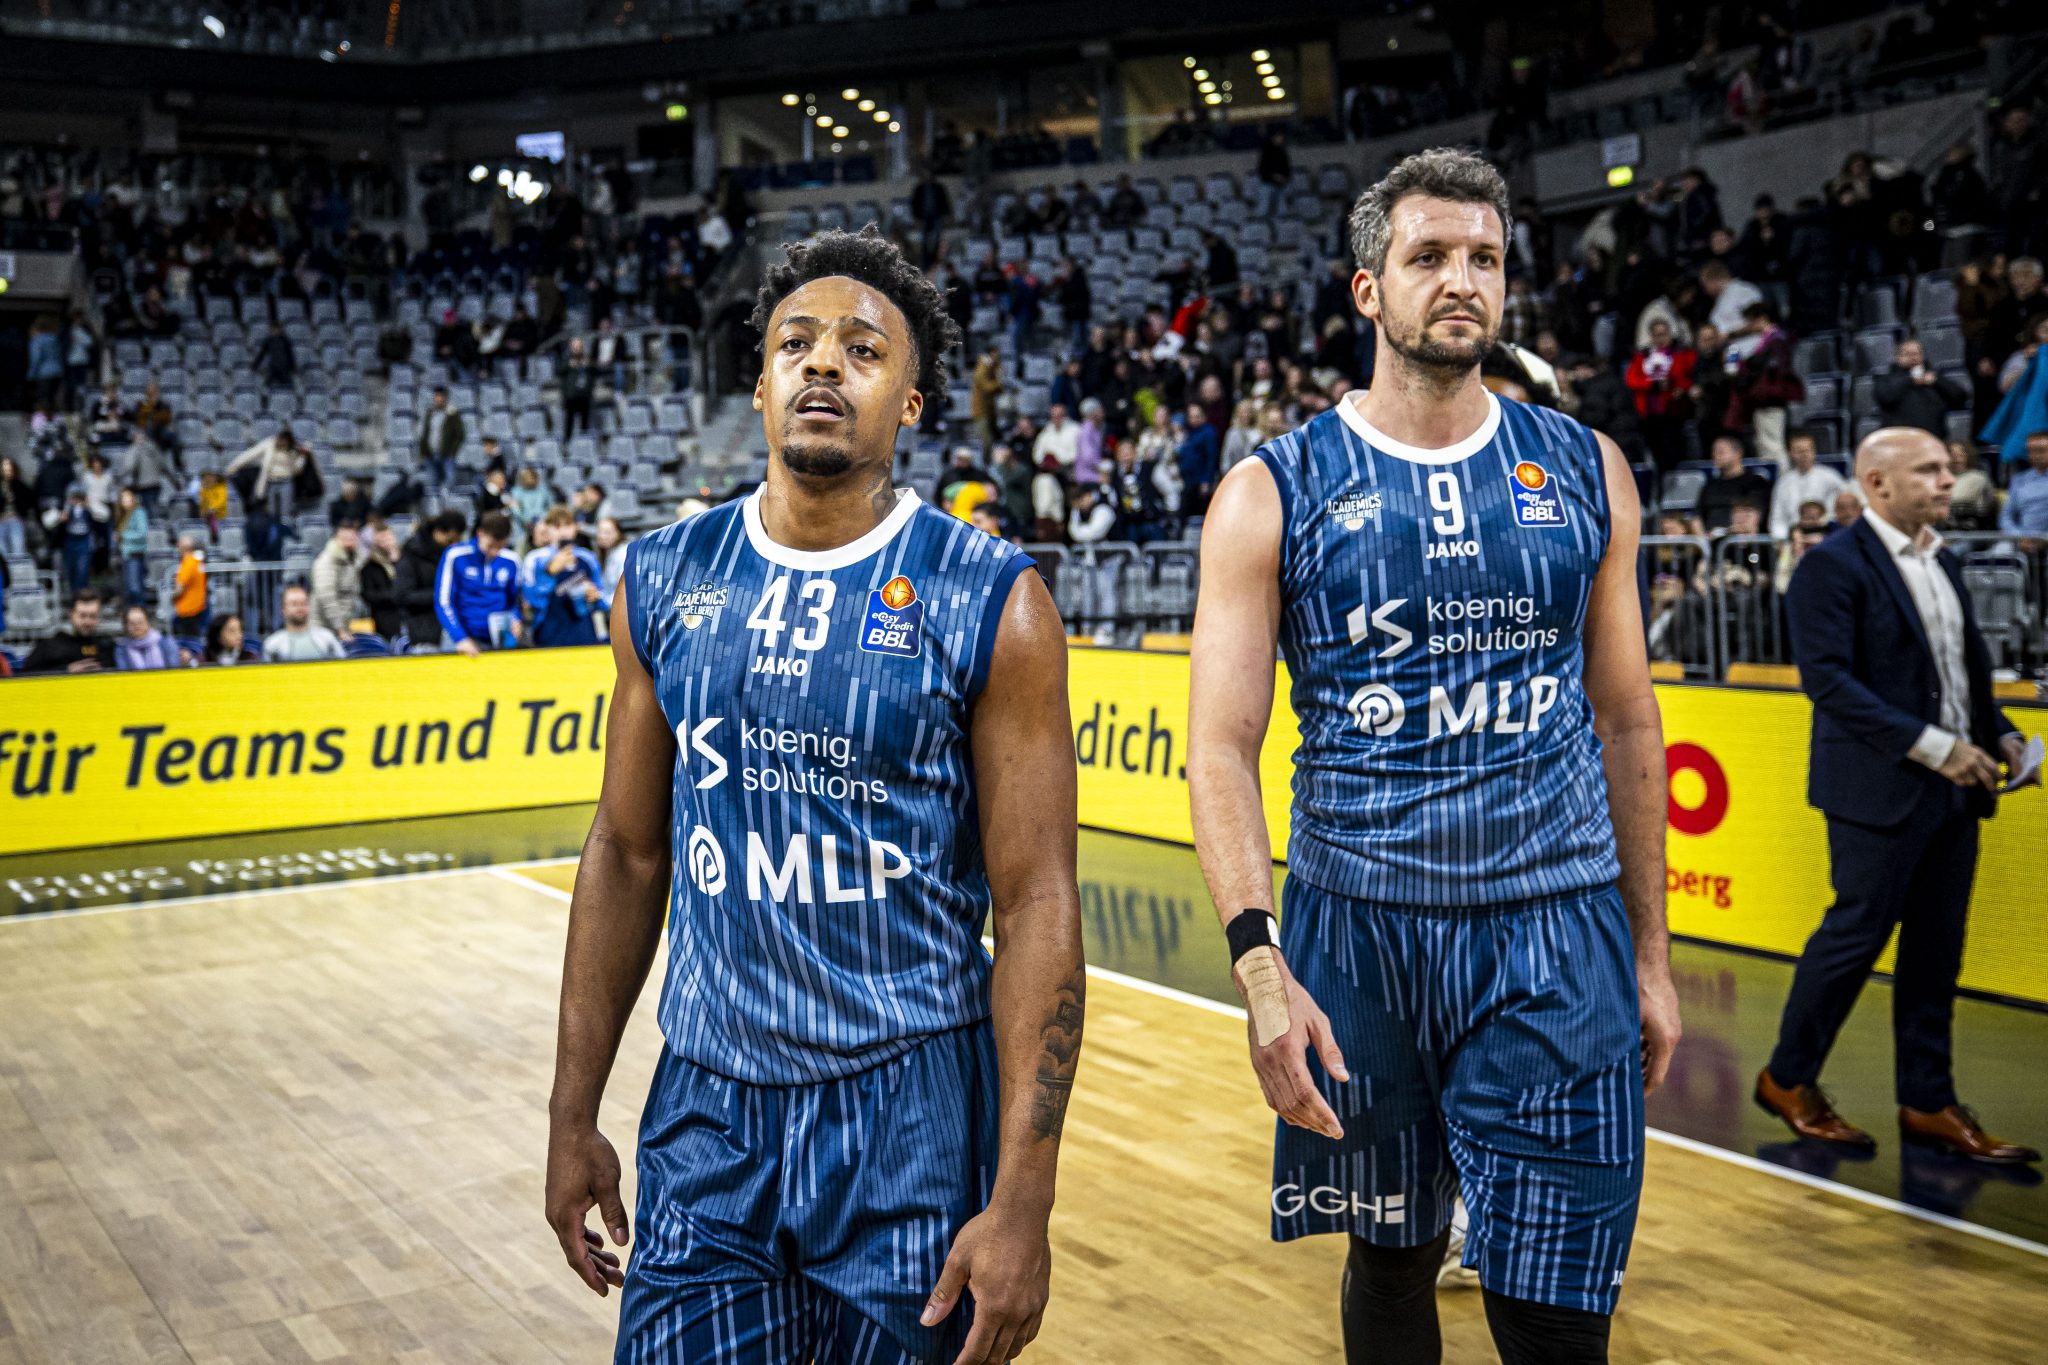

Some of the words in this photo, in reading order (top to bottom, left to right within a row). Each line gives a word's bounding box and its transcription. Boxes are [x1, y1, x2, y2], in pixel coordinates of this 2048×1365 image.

[1326, 493, 1382, 515] ACADEMICS
[1335, 509, 1374, 524] HEIDELBERG
[1428, 472, 1465, 535] 9
[1522, 506, 1560, 522] BBL
[1530, 498, 1557, 508] Credit
[1425, 540, 1480, 560] JAKO
[745, 575, 837, 651] 43
[1426, 591, 1540, 623] koenig.
[866, 628, 911, 650] BBL
[883, 620, 914, 632] Credit
[1428, 626, 1559, 655] solutions
[751, 655, 808, 677] JAKO
[1428, 675, 1560, 740] MLP
[0, 729, 96, 798] für
[120, 723, 346, 789] Teams
[371, 699, 496, 768] und
[741, 718, 857, 767] koenig.
[1076, 701, 1187, 780] dich.
[742, 762, 888, 803] solutions
[747, 831, 912, 904] MLP
[1271, 1183, 1382, 1224] GGH
